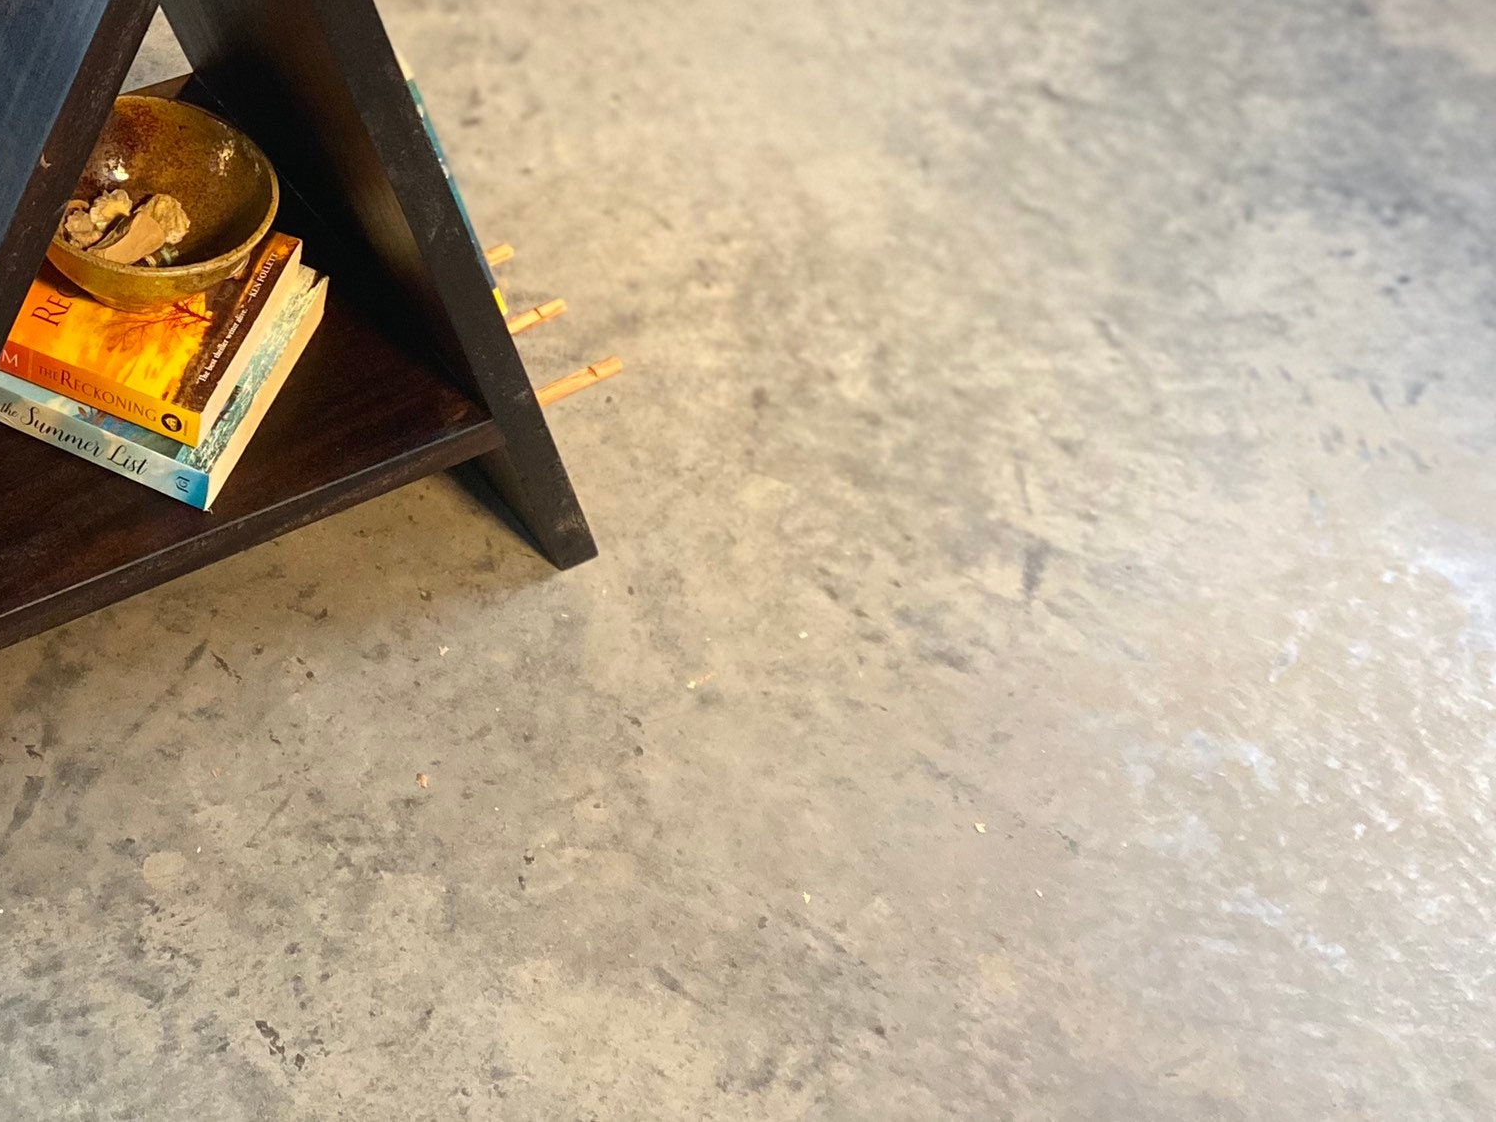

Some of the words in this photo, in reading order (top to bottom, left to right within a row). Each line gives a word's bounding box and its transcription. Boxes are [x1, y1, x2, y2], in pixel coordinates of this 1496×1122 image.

[205, 358, 218, 372] best
[212, 338, 229, 359] thriller
[225, 321, 239, 340] writer
[256, 253, 279, 283] FOLLETT
[38, 365, 59, 382] THE
[59, 369, 157, 423] RECKONING
[0, 401, 18, 419] the
[20, 406, 104, 458] Summer
[107, 444, 149, 476] List
